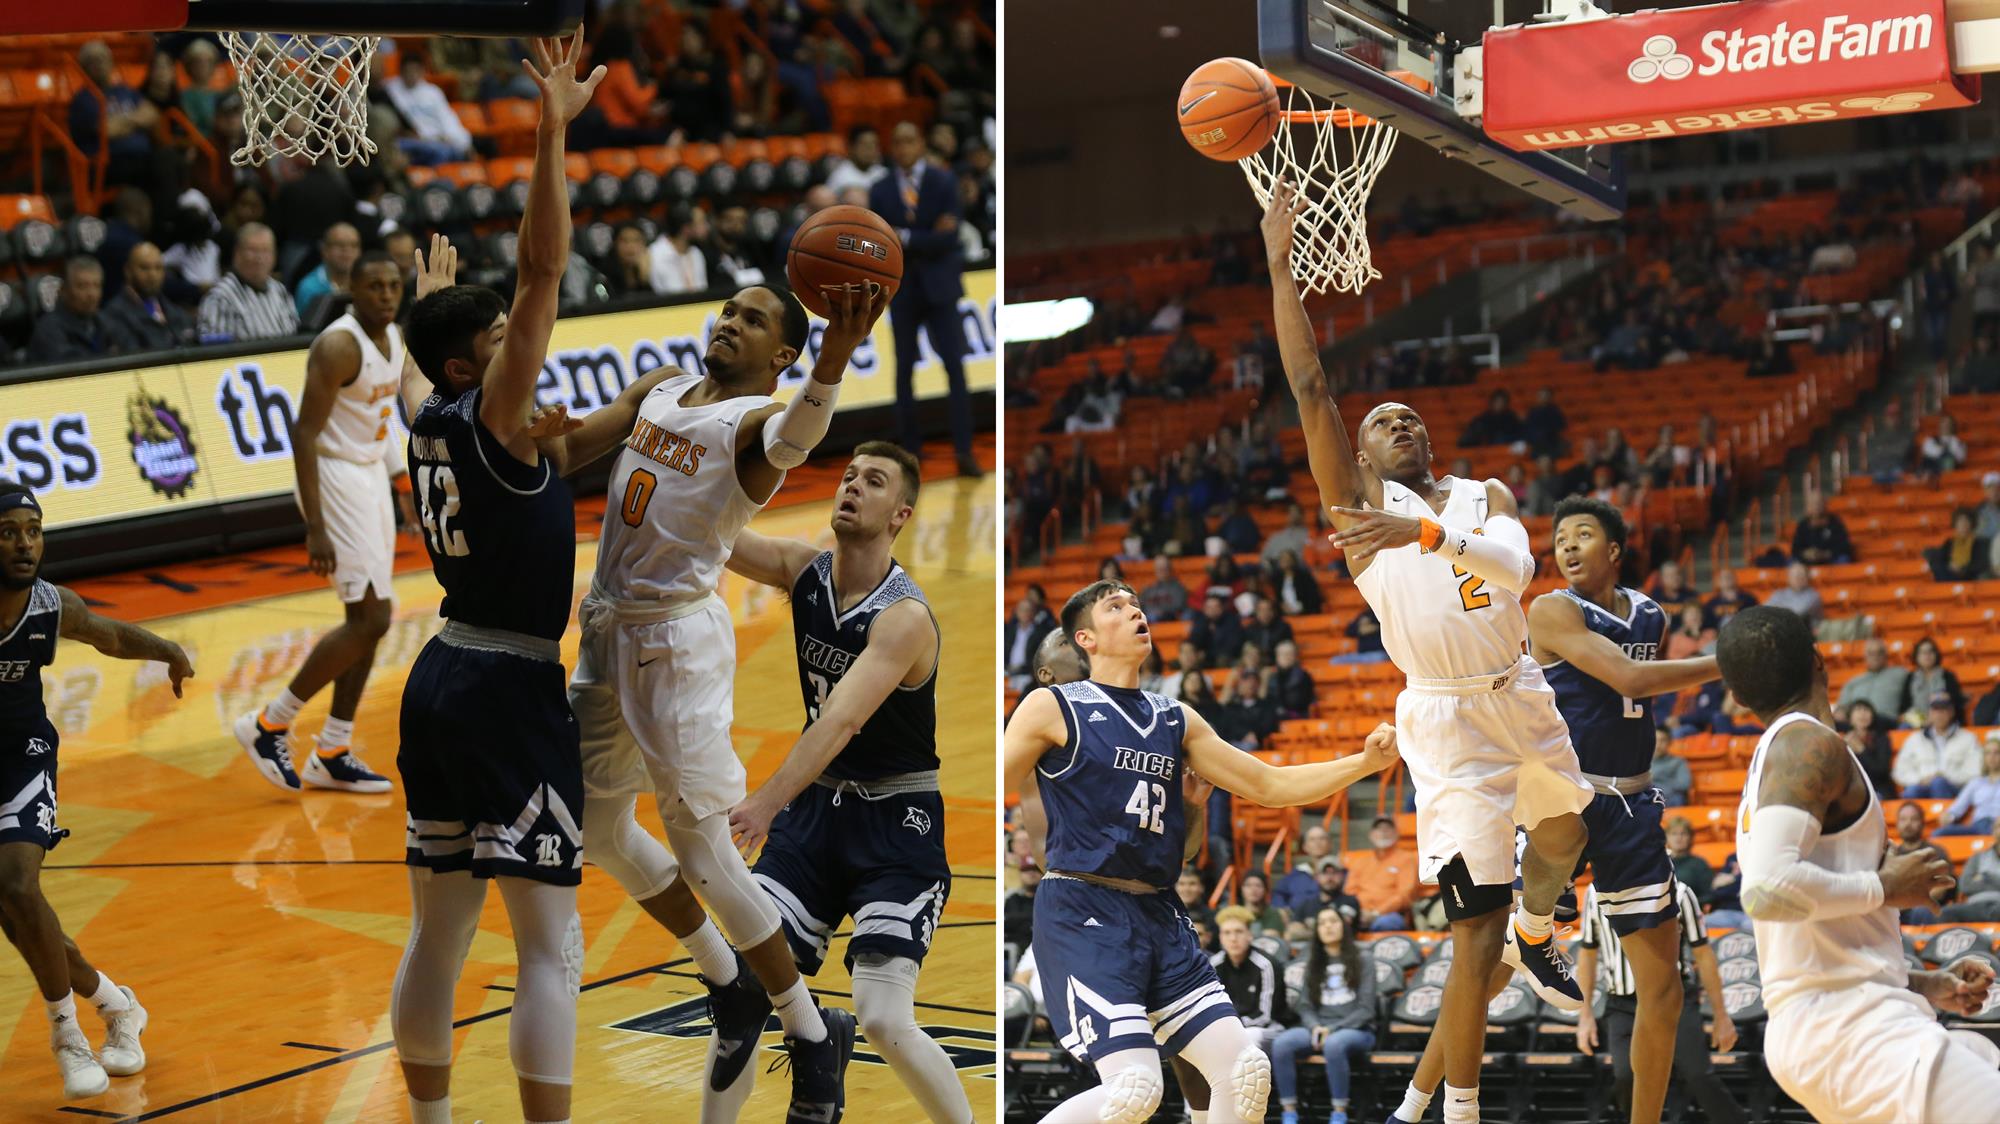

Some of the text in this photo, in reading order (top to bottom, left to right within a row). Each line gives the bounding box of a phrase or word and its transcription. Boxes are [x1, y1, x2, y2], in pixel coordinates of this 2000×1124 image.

[0, 419, 97, 490] ss
[220, 368, 299, 458] th
[621, 467, 658, 529] 0
[1113, 746, 1176, 781] RICE
[1125, 779, 1167, 835] 42
